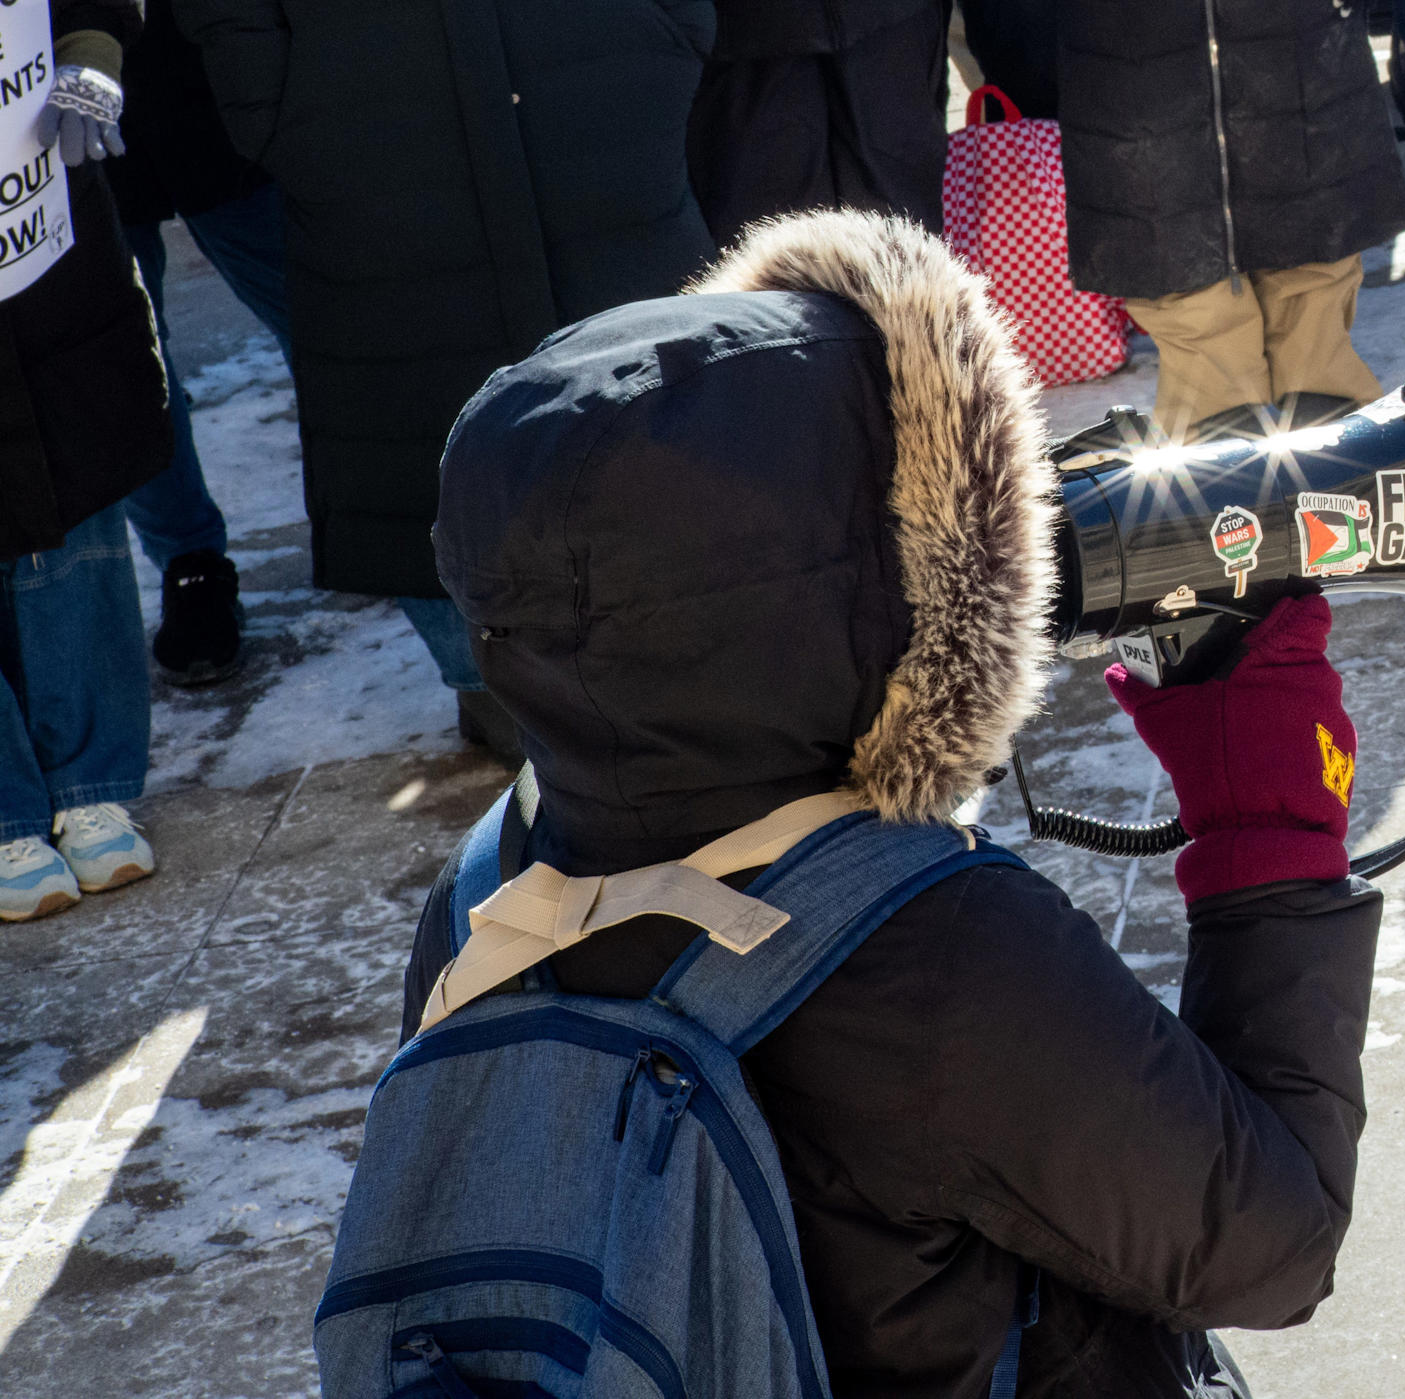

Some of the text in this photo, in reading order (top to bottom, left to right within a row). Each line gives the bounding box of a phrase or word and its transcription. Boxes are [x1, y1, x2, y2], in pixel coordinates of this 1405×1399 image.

[1301, 495, 1367, 518] OCCUPATION IS
[1220, 516, 1244, 533] STOP
[1222, 528, 1250, 546] WARS
